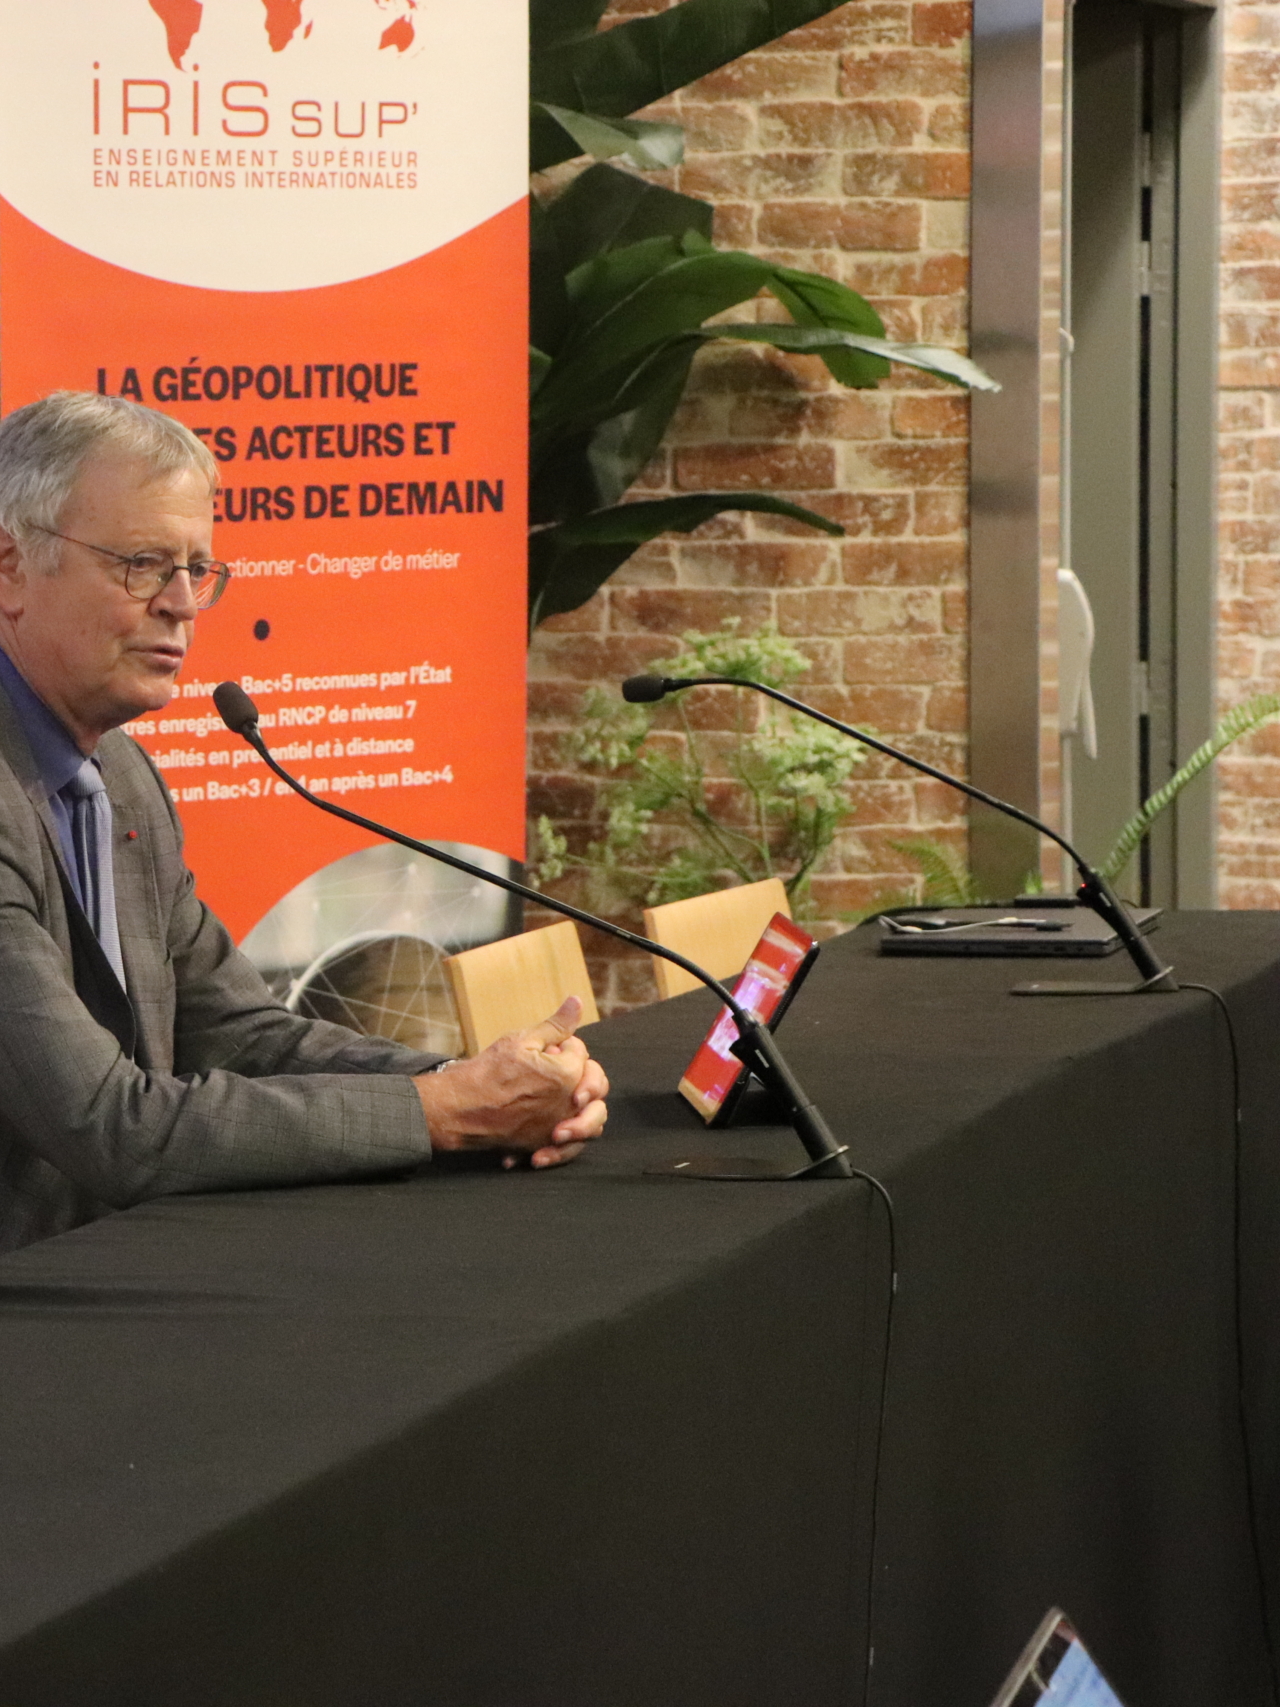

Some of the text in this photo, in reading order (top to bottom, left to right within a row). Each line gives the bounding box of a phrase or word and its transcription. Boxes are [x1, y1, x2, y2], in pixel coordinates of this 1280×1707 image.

[93, 146, 418, 168] ENSEIGNEMENT SUPÉRIEUR
[93, 170, 418, 189] EN RELATIONS INTERNATIONALES
[152, 356, 418, 403] GÉOPOLITIQUE
[245, 422, 405, 460] ACTEURS
[413, 421, 456, 455] ET
[213, 479, 505, 522] EURS DE DEMAIN
[226, 557, 296, 578] ctionner
[306, 552, 378, 579] Changer
[380, 551, 404, 572] de
[406, 547, 461, 570] métier
[241, 674, 293, 694] Bac+5
[295, 671, 378, 691] reconnues
[380, 670, 408, 690] par
[278, 705, 326, 727] RNCP
[328, 704, 349, 723] de
[351, 702, 404, 721] niveau
[405, 700, 418, 718] 7
[208, 750, 230, 766] en
[315, 740, 331, 758] et
[333, 737, 345, 757] à
[346, 736, 415, 756] distance
[182, 784, 204, 801] un
[206, 777, 260, 800] Bac+3
[309, 777, 329, 793] an
[331, 770, 376, 795] après
[378, 772, 399, 788] un
[401, 764, 453, 786] Bac+4
